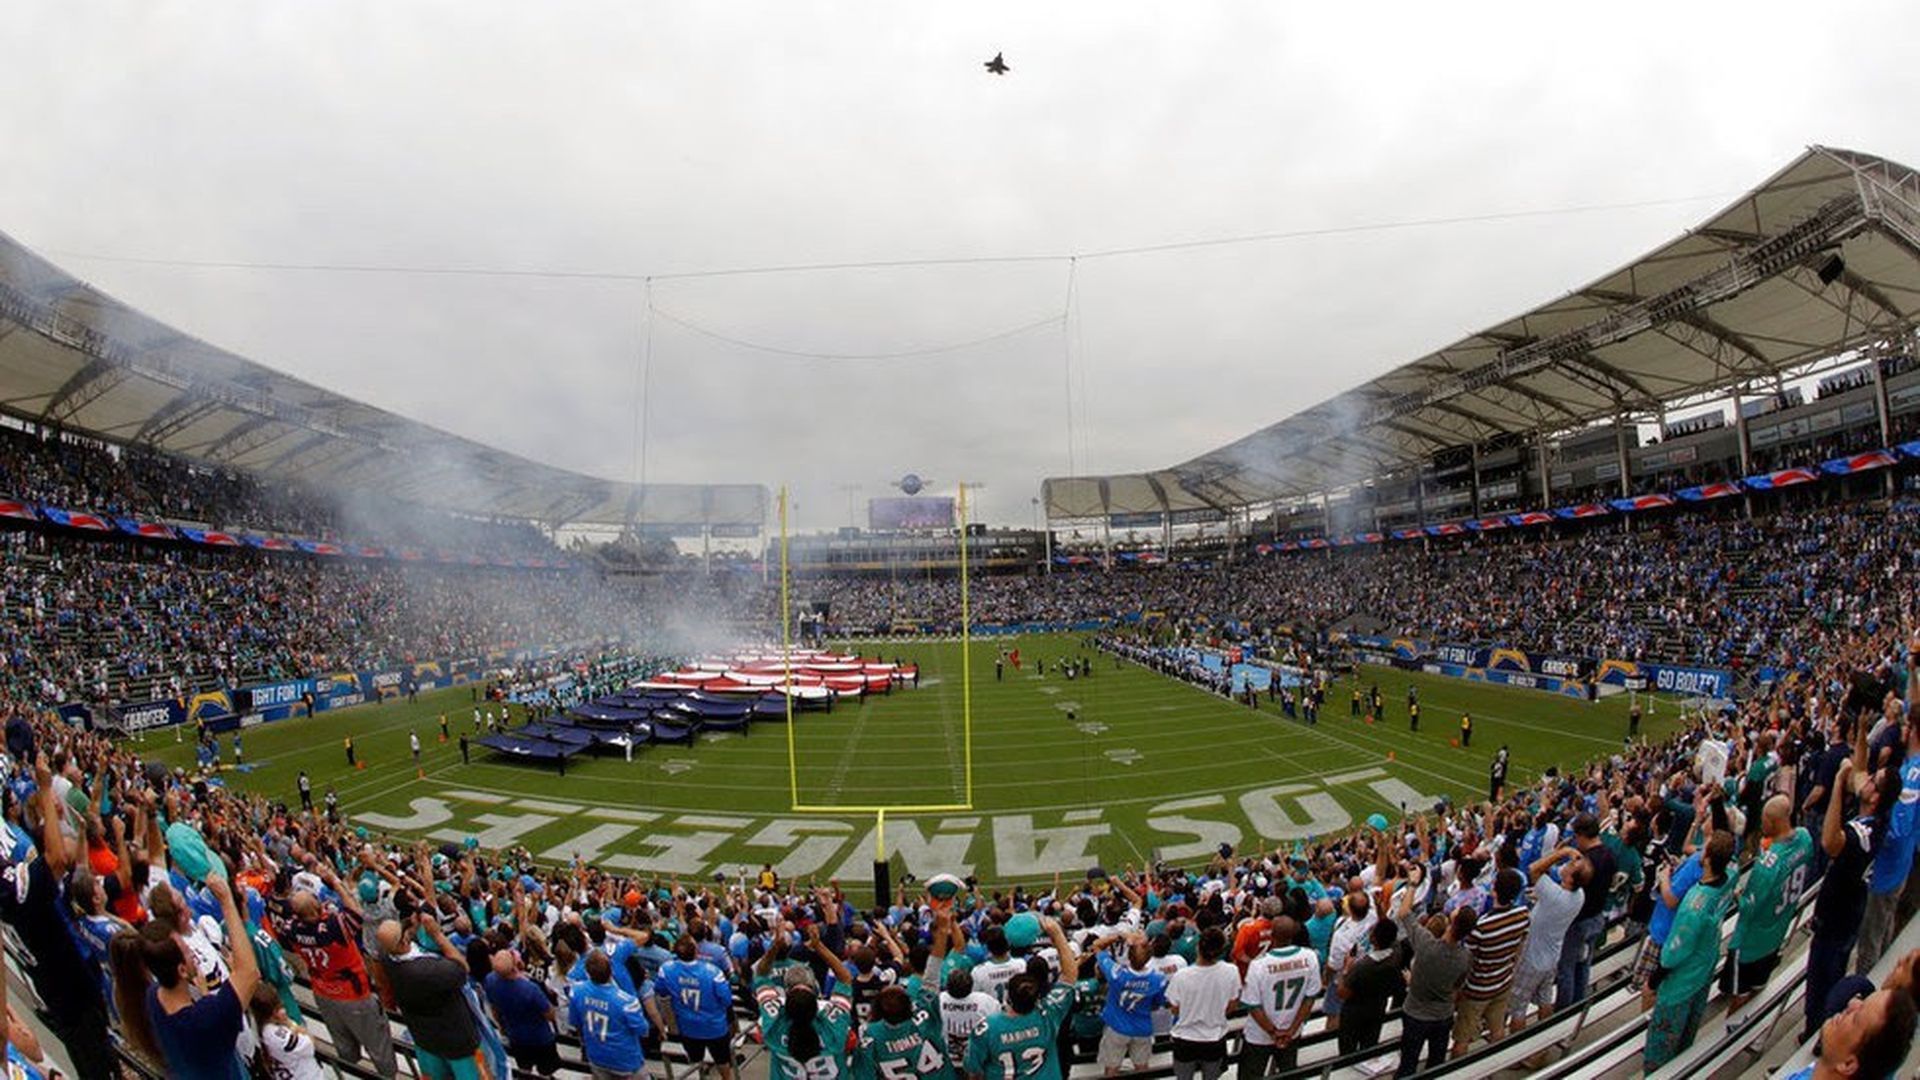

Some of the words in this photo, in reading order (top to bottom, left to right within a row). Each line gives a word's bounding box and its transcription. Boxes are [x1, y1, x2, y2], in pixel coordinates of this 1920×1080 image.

[276, 683, 296, 703] FOR
[1657, 669, 1675, 689] GO
[1146, 766, 1446, 863] LOS
[349, 789, 1112, 882] ANGELES
[680, 988, 701, 1012] 17
[943, 1002, 978, 1012] ROMERO
[1119, 990, 1144, 1012] 17
[1272, 976, 1306, 1012] 17
[586, 1009, 609, 1042] 17
[879, 1039, 944, 1080] 54
[998, 1046, 1045, 1080] 13
